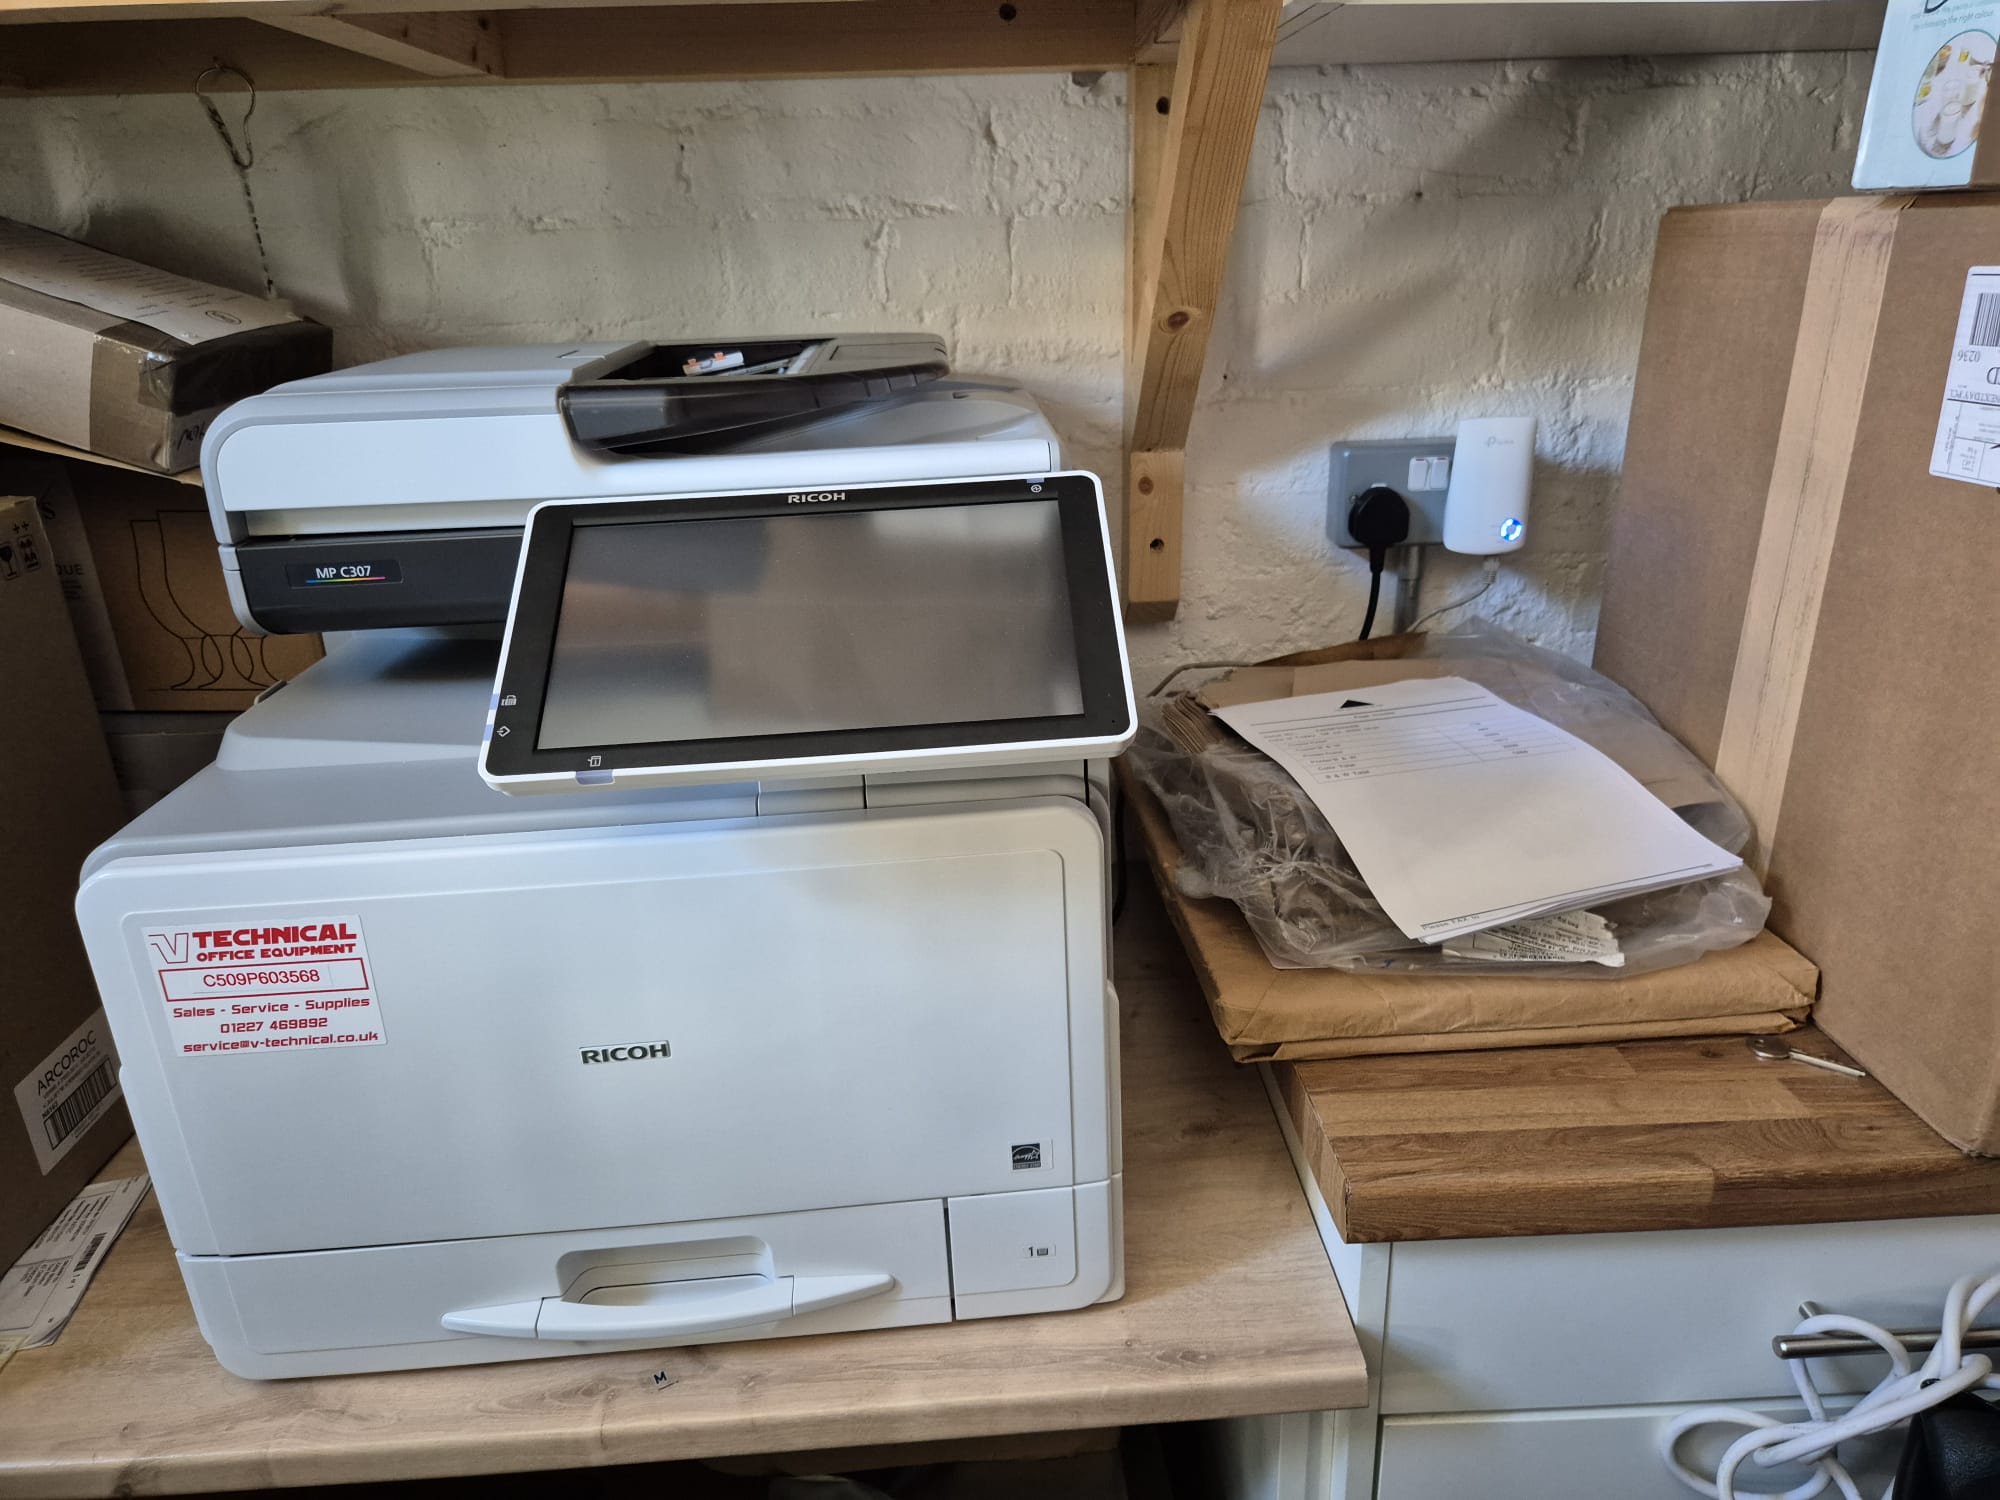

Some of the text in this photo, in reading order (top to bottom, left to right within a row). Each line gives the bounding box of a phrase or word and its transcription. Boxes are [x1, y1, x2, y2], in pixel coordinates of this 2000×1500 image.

[1957, 350, 1981, 362] 0236
[787, 492, 846, 504] RICOH
[316, 565, 371, 579] MP C307
[192, 923, 357, 949] TECHNICAL
[196, 943, 357, 962] OFFICE EQUIPMENT
[203, 969, 320, 987] C509P603568
[173, 1007, 215, 1018] Sales
[231, 1002, 289, 1015] Service
[305, 997, 371, 1011] Supplies
[220, 1017, 328, 1034] 01227 469892
[183, 1031, 379, 1053] service@v-technical.co.uk
[581, 1043, 668, 1064] RICOH
[37, 1030, 97, 1096] ARCOROC
[1028, 1246, 1034, 1257] 1
[653, 1371, 667, 1384] M
